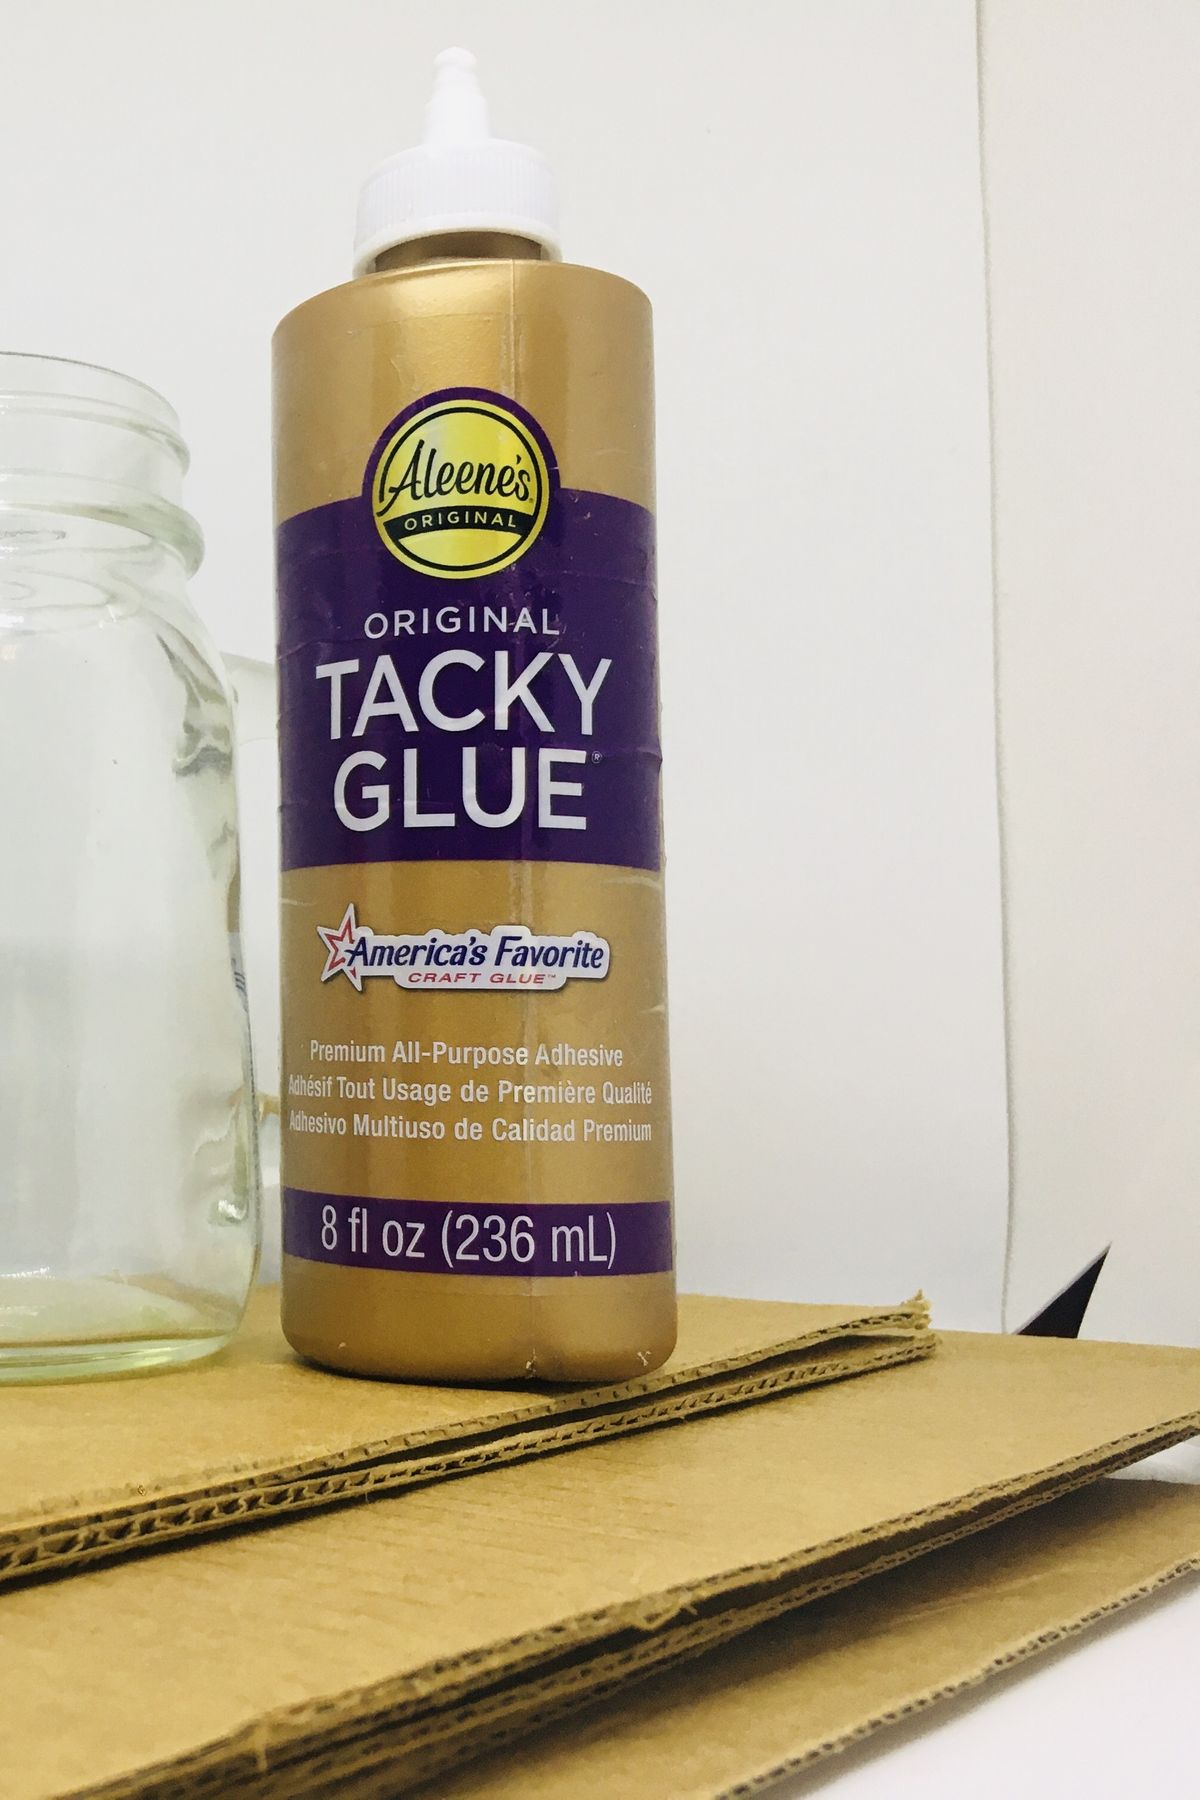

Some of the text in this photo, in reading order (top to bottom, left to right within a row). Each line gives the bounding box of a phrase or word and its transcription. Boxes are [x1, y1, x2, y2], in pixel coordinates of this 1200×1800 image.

[376, 439, 531, 517] Aleene's
[404, 511, 517, 531] ORIGINAL
[364, 606, 560, 639] ORIGINAL
[315, 649, 612, 740] TACKY
[333, 746, 587, 832] GLUE
[345, 936, 604, 969] America's Favorite
[407, 972, 547, 984] CRAFT GLUE
[310, 1040, 623, 1069] Premium All-Purpose Adhesive
[288, 1074, 653, 1106] Adhésif Tout Usage de Première Qualité
[289, 1110, 652, 1142] Adhesivo Multiuso de Calidad Premium
[321, 1205, 617, 1269] 8 fl oz (236 mL)
